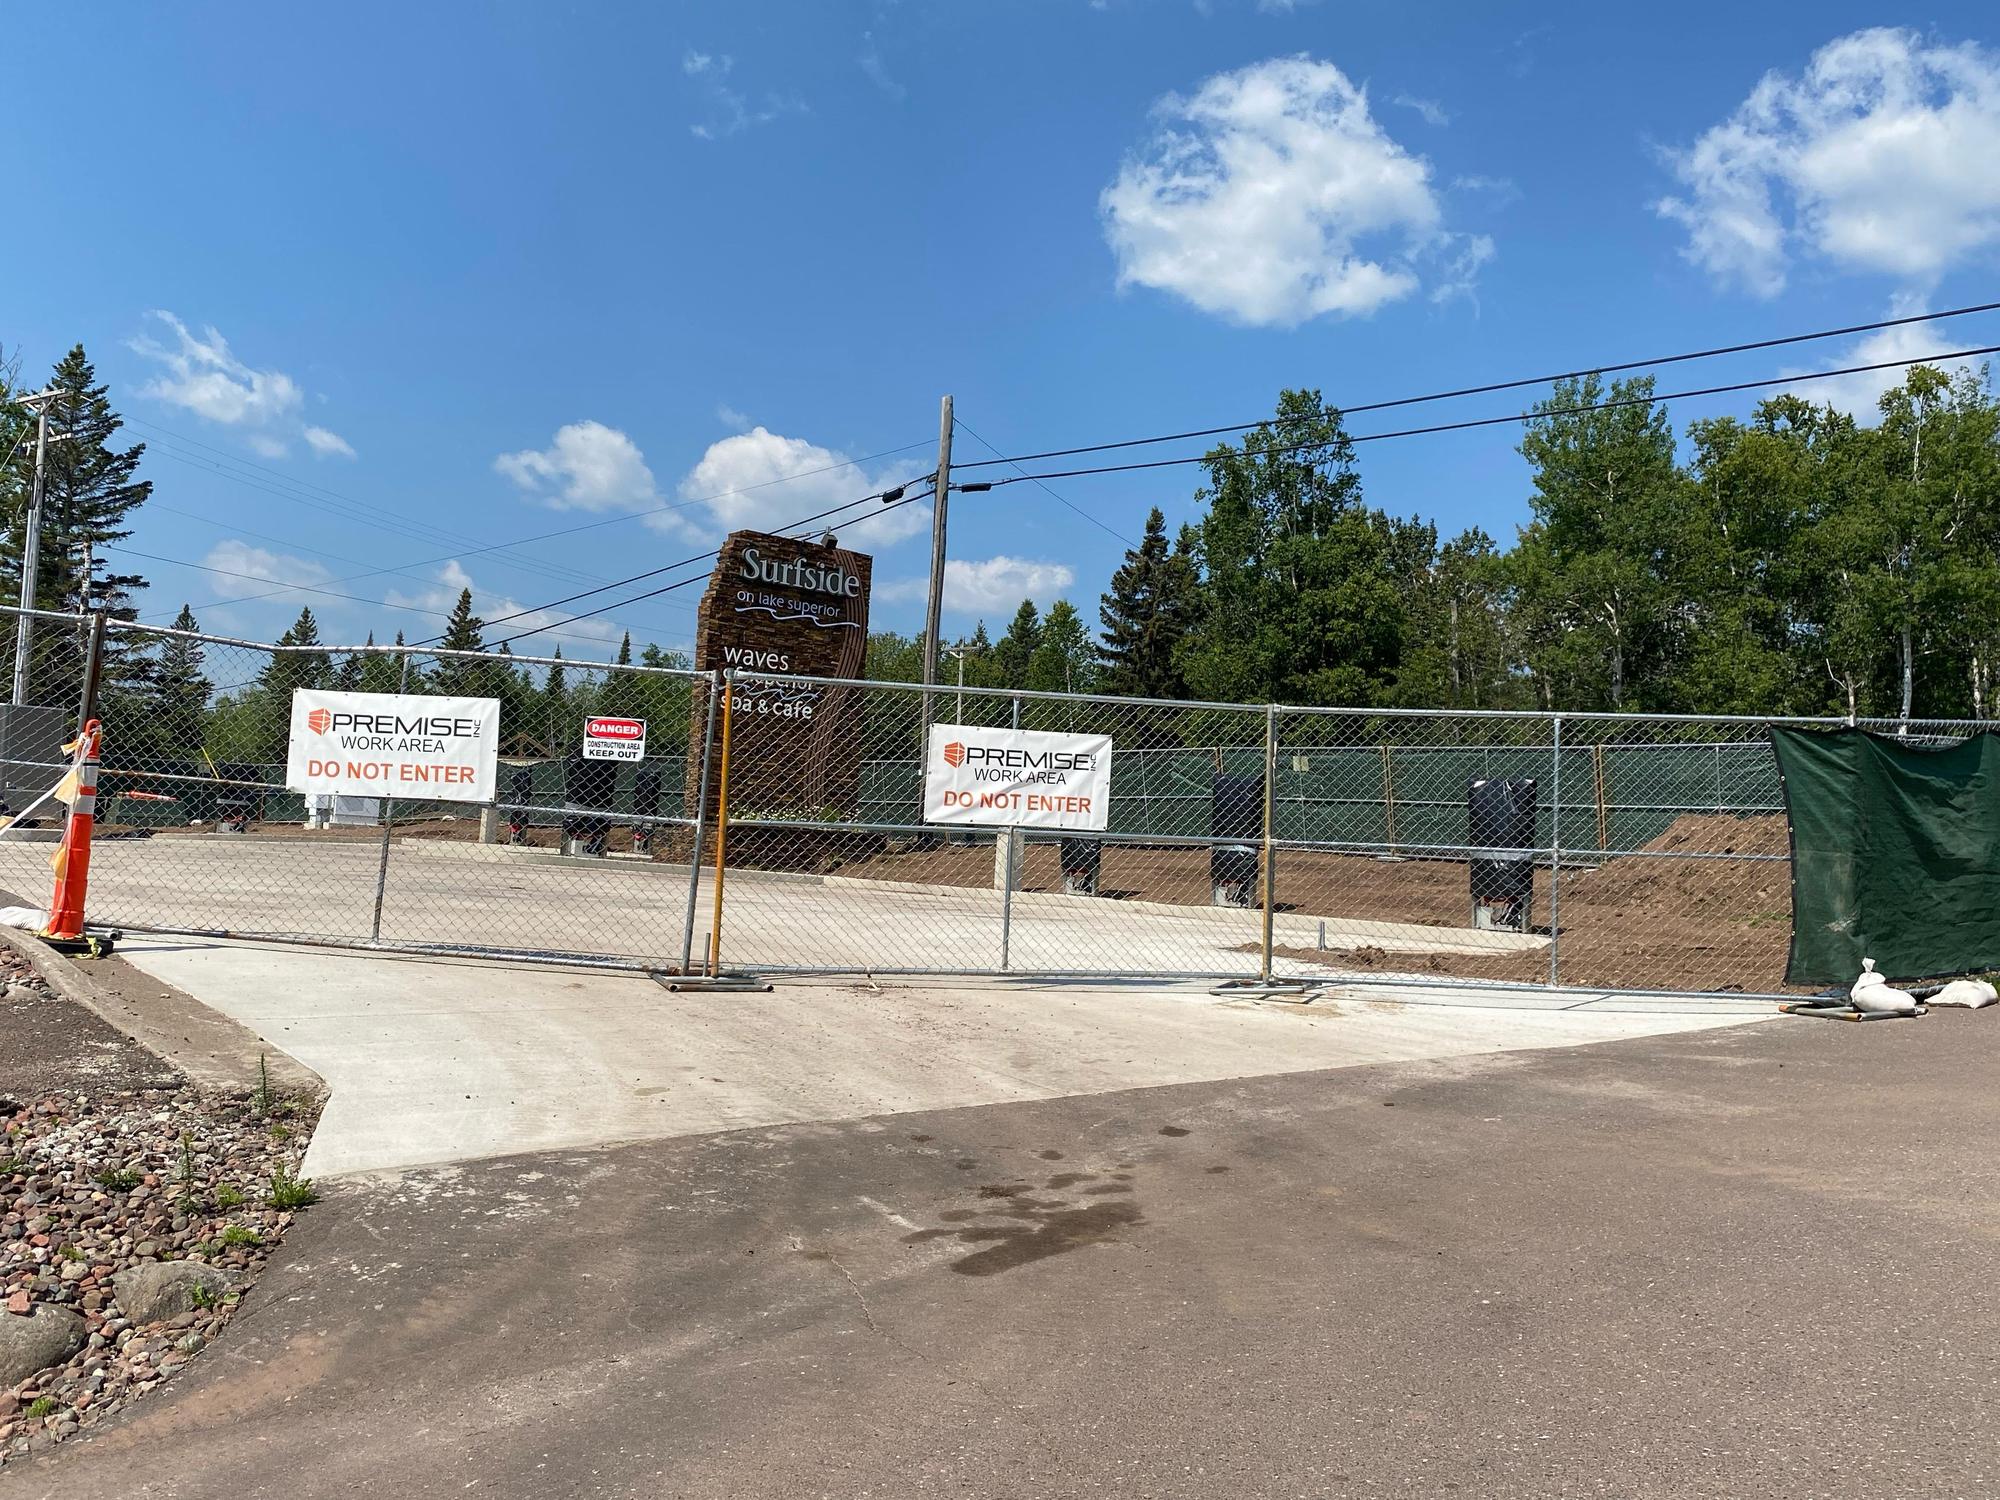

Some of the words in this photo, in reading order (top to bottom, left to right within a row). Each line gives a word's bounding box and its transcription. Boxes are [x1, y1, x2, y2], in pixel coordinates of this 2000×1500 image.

[742, 548, 860, 597] Surfside
[737, 591, 754, 603] on
[759, 592, 785, 608] lake
[787, 600, 840, 617] superior
[723, 646, 789, 671] waves
[758, 699, 768, 714] &
[772, 700, 813, 719] cafe
[332, 713, 473, 738] PREMISE
[591, 723, 639, 735] DANGER
[341, 735, 393, 751] WORK
[397, 738, 445, 753] AREA
[587, 740, 626, 749] CONSTRUCTION
[626, 742, 640, 750] AREA
[589, 749, 614, 757] KEEP
[617, 750, 638, 759] OUT
[966, 747, 1090, 771] PREMISE
[308, 760, 340, 778] DO
[347, 762, 393, 780] NOT
[400, 764, 475, 784] ENTER
[974, 767, 1023, 783] WORK
[1025, 771, 1066, 785] AREA
[944, 790, 973, 808] DO
[980, 792, 1021, 810] NOT
[1027, 795, 1091, 813] ENTER
